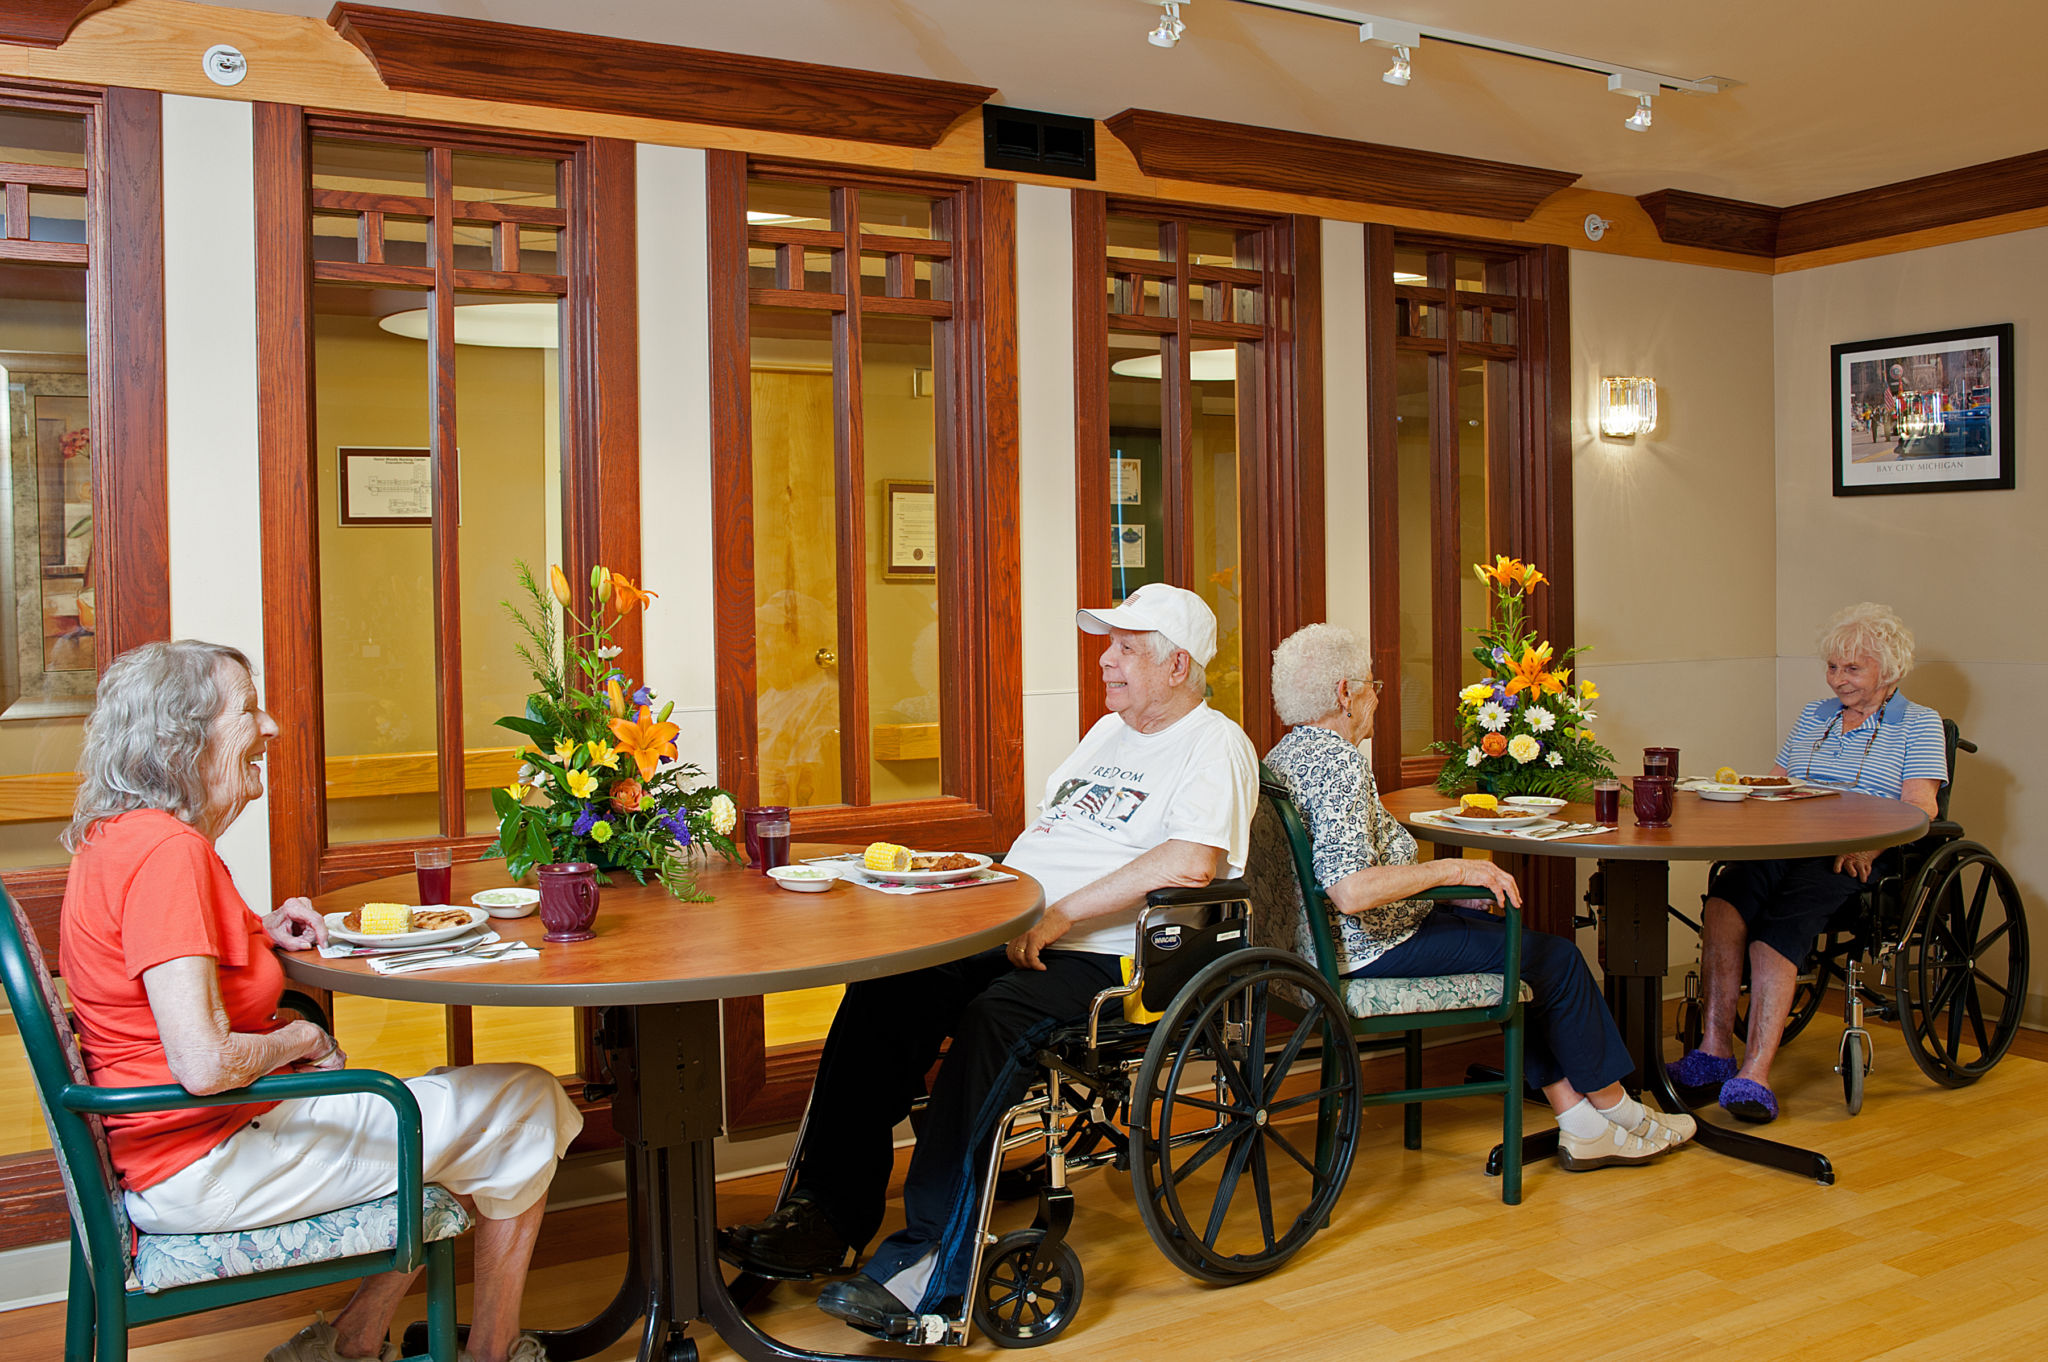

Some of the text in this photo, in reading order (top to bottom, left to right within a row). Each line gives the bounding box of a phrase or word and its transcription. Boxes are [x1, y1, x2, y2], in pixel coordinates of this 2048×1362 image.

[1876, 461, 1964, 472] BAY CITY MICHIGAN
